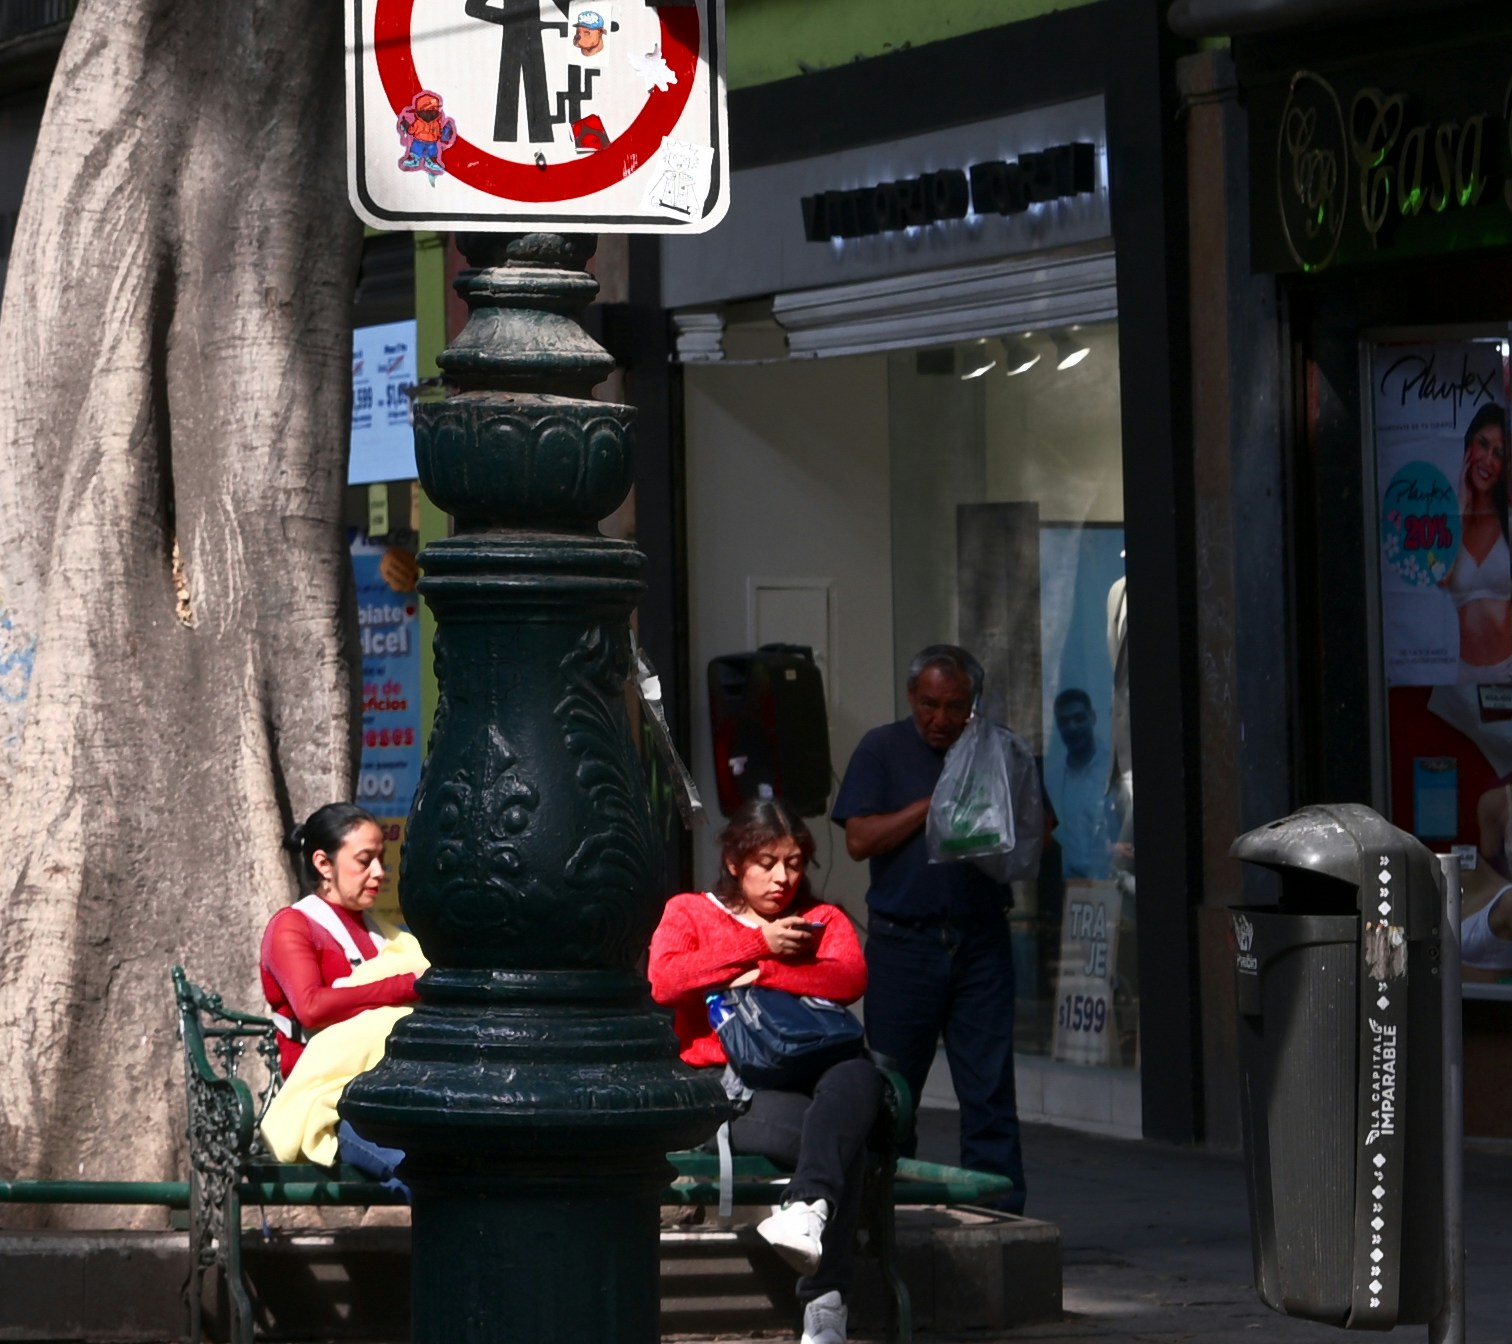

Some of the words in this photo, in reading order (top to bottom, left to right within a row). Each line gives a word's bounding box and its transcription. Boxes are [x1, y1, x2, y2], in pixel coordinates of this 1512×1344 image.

[1350, 85, 1488, 242] Casa
[1380, 352, 1496, 430] Playtex
[1404, 514, 1453, 550] 20%
[1070, 902, 1107, 940] TRA
[1084, 940, 1108, 978] JE
[1371, 1031, 1383, 1102] CAPITAL
[1380, 1024, 1397, 1136] IMPARABLE
[1371, 1109, 1380, 1129] LA
